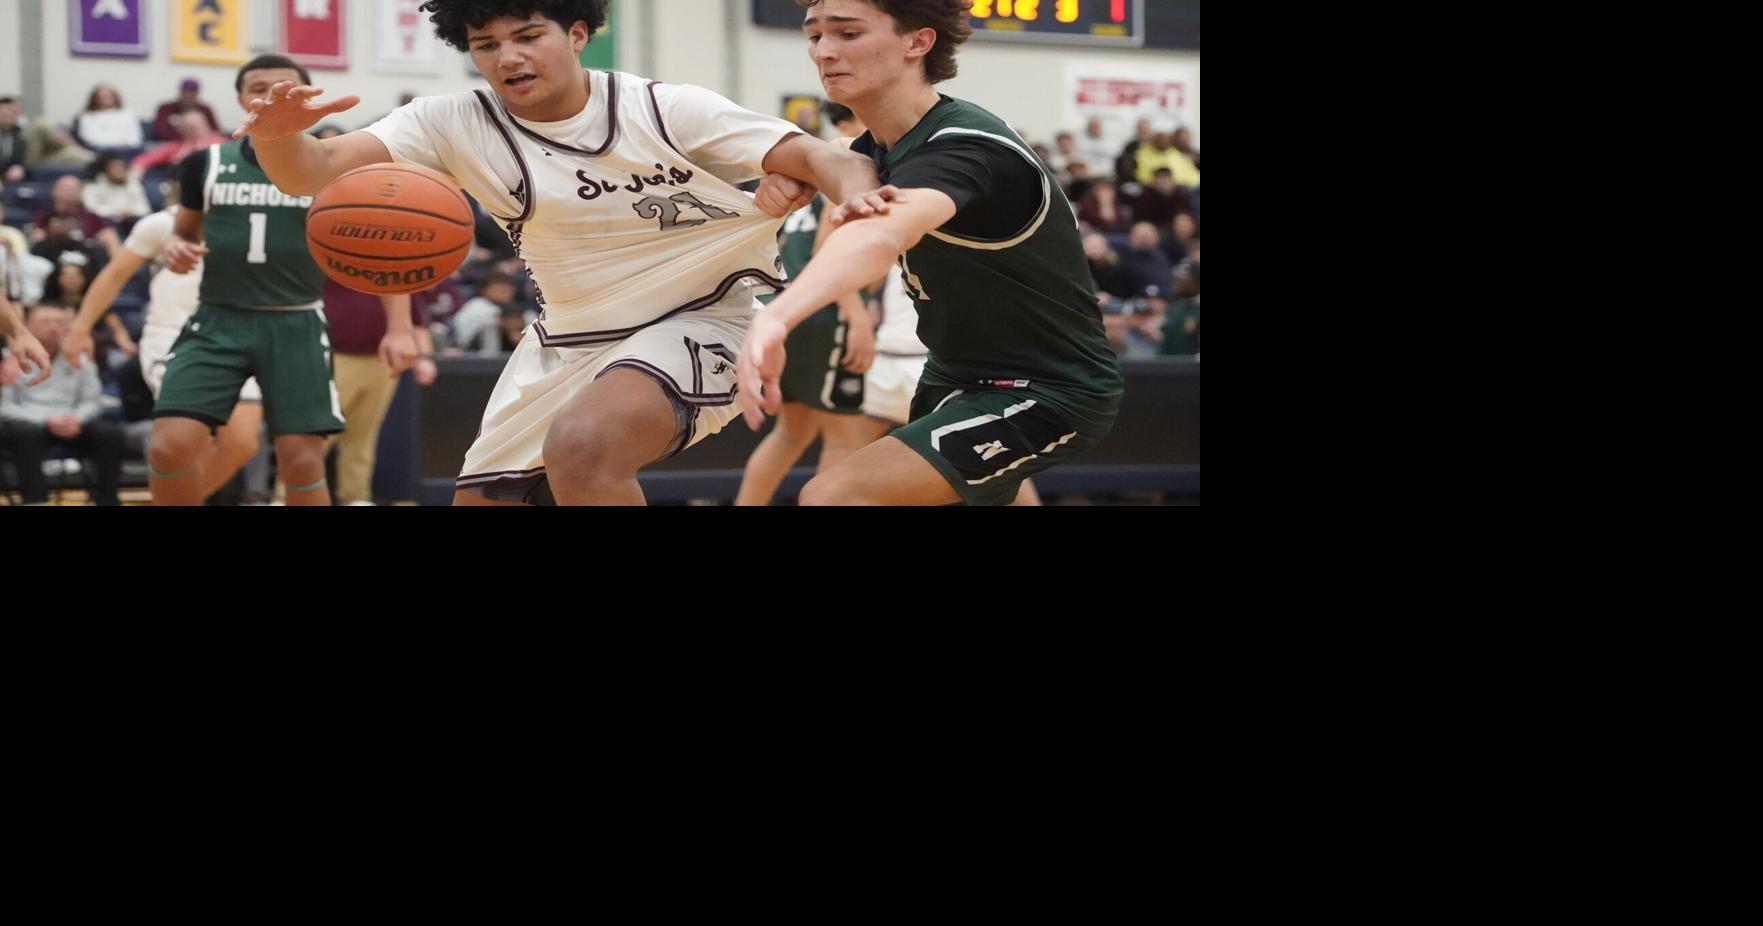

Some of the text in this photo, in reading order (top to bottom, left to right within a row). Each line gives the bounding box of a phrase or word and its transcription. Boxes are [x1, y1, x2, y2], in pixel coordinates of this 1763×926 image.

[247, 212, 267, 263] 1
[330, 223, 436, 243] EVOLUTION
[326, 256, 437, 286] Wilson
